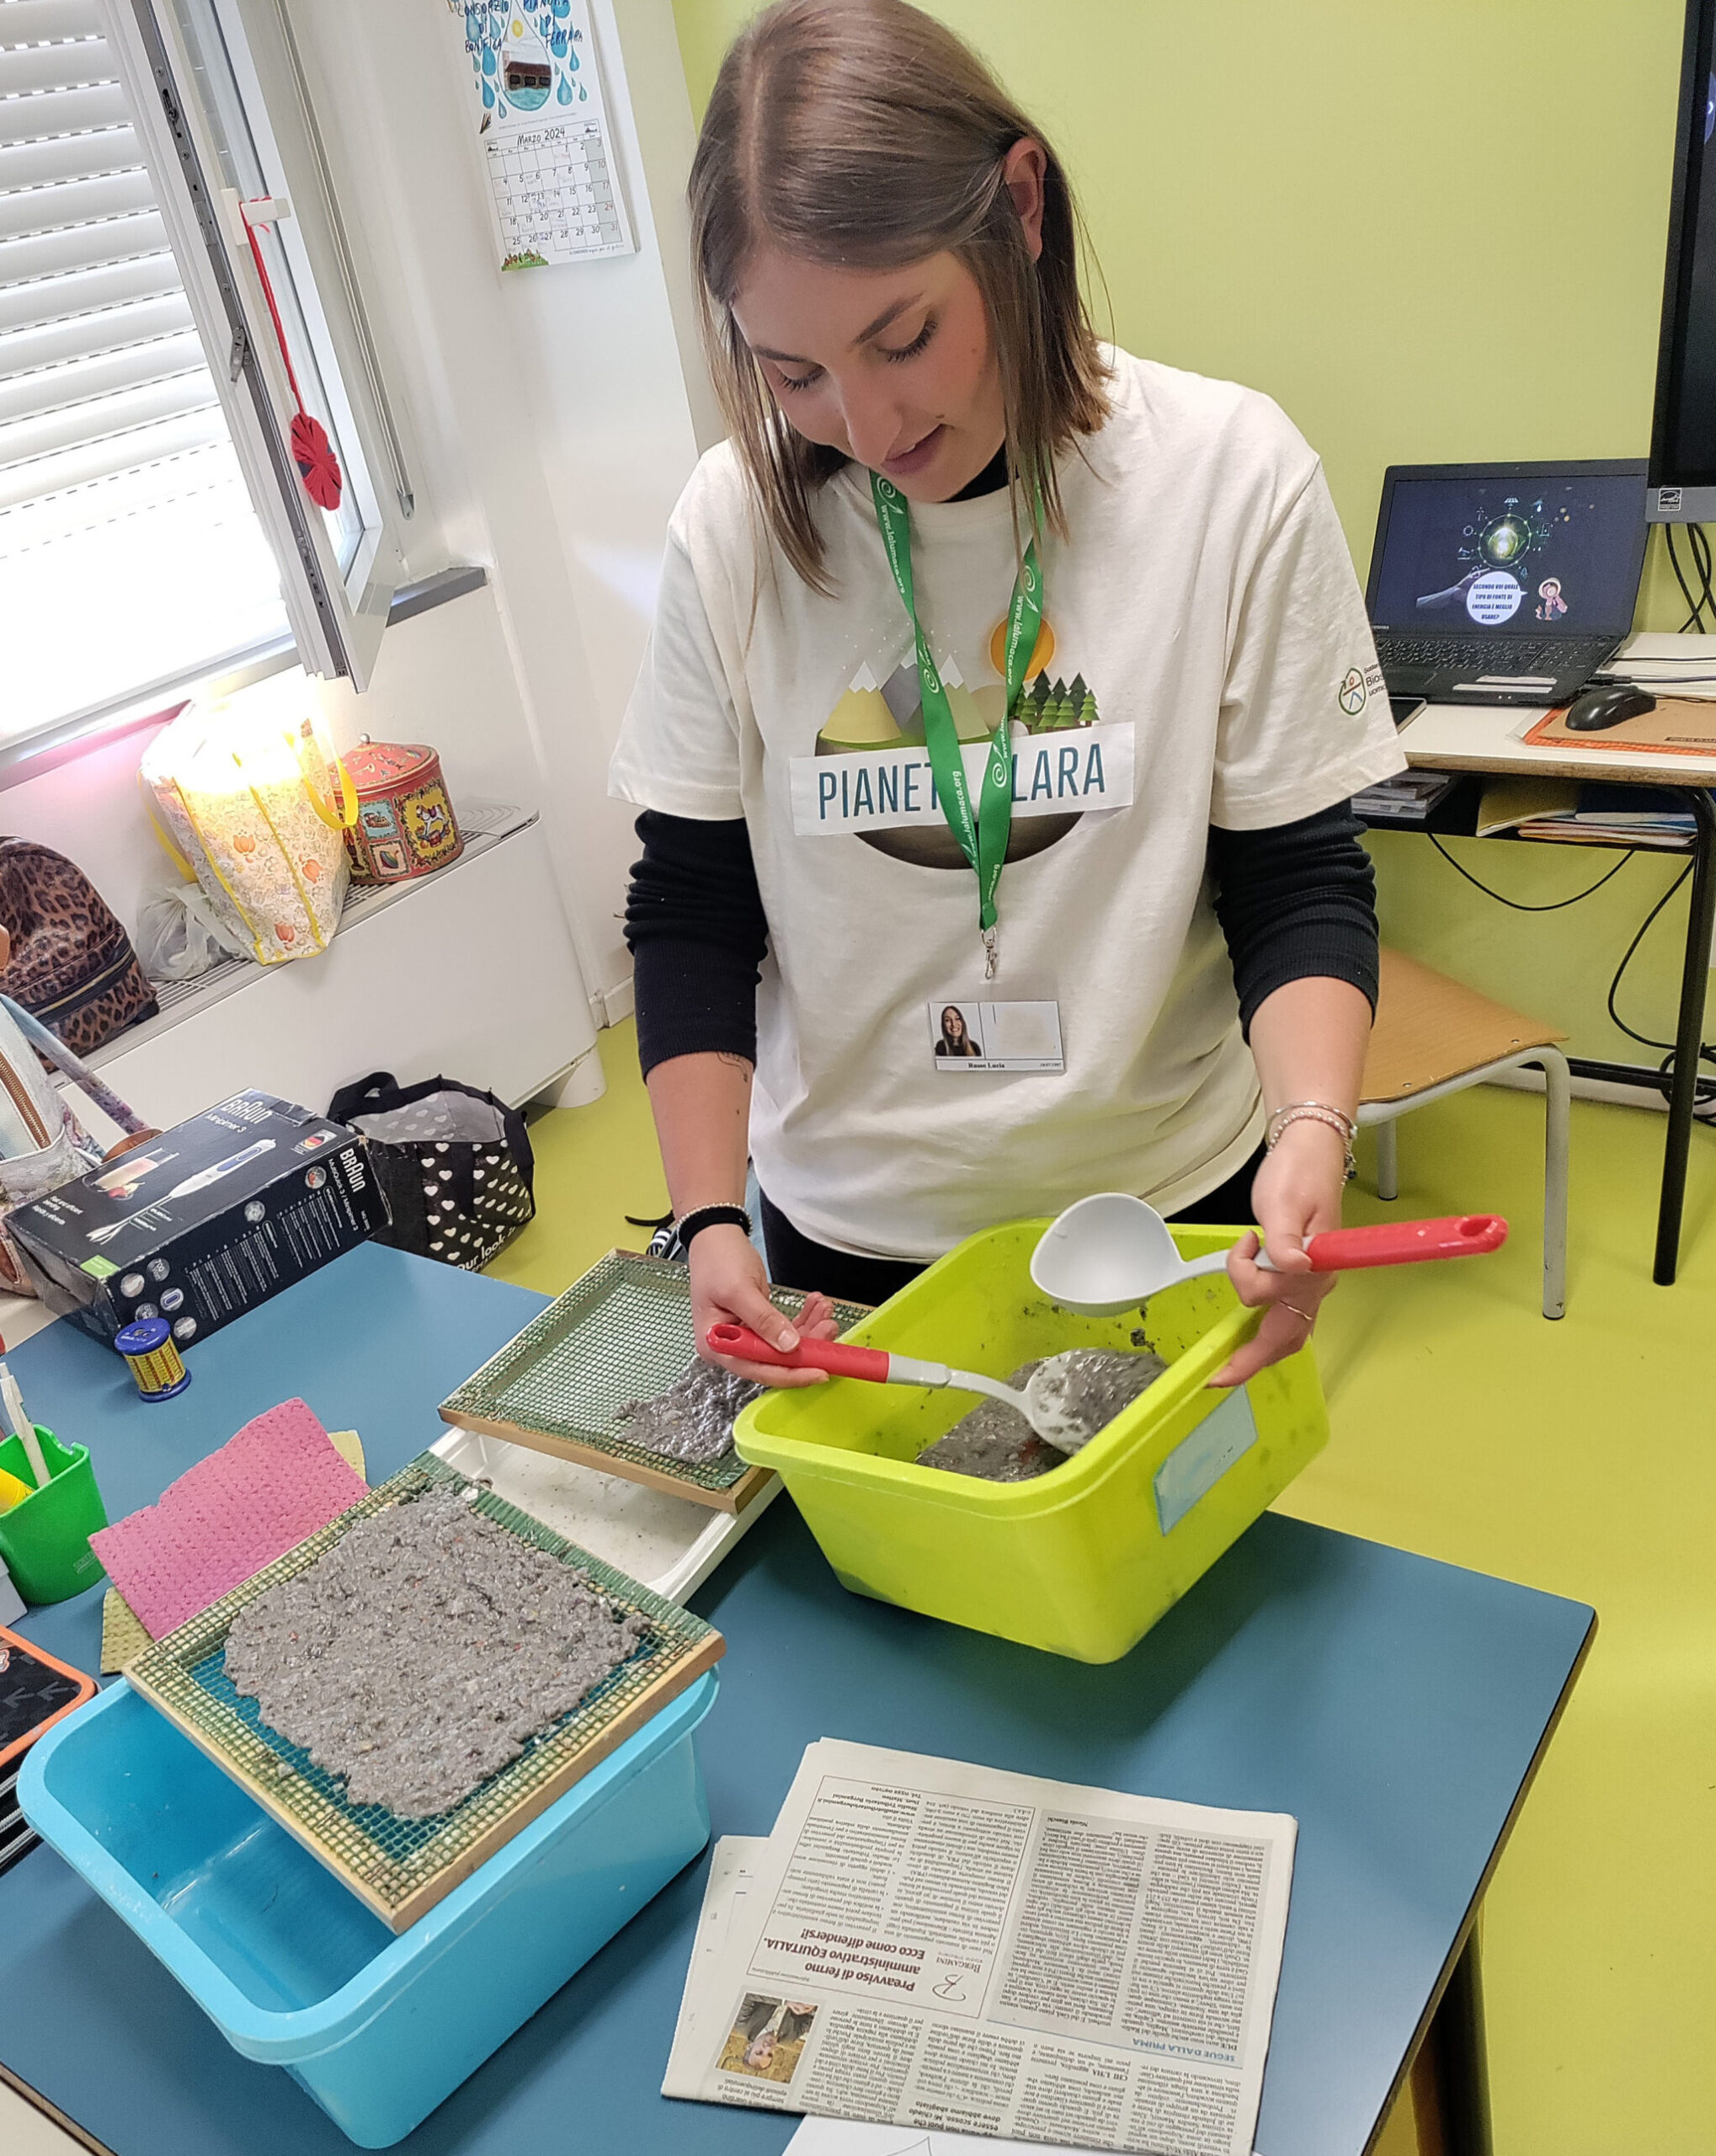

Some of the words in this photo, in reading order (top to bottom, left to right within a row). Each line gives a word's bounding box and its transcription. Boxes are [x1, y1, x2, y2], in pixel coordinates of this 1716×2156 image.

[546, 29, 583, 48] FERRARA
[544, 127, 565, 141] 2024
[540, 212, 548, 221] 20
[557, 210, 564, 218] 21
[572, 207, 579, 216] 22
[605, 202, 613, 211] 24
[545, 232, 552, 241] 27
[560, 230, 568, 238] 28
[575, 227, 584, 236] 29
[591, 225, 600, 233] 30
[881, 504, 905, 594] www.lalumaca.org
[1005, 595, 1024, 685] www.lalumaca.org
[818, 762, 939, 820] PIANET
[1011, 743, 1106, 803] LARA
[221, 1098, 274, 1124] BRAUN
[205, 1113, 238, 1131] Minipimer
[339, 1147, 366, 1193] BRAUN
[832, 1792, 864, 1802] Bergamini
[864, 1798, 896, 1807] Tributario
[813, 1843, 840, 1852] Bergamini
[842, 1848, 869, 1857] Tributario
[799, 1927, 865, 1950] difendersi!
[760, 1935, 829, 1958] EQUITALIA.
[864, 1939, 898, 1953] come
[897, 1945, 925, 1960] Ecco
[802, 1961, 840, 1978] fermo
[828, 1949, 920, 1976] amministrativo
[935, 1956, 981, 1973] BERGAMINI
[840, 1968, 855, 1981] di
[854, 1971, 915, 1992] Preavviso
[1132, 2037, 1165, 2050] PRIMA
[1167, 2044, 1202, 2057] DALLA
[1202, 2050, 1235, 2063] SEGUE
[907, 2108, 932, 2119] chiedo
[914, 2100, 948, 2113] sbagliato
[948, 2107, 981, 2119] abbiamo
[945, 2115, 971, 2125] scosso.
[982, 2113, 1000, 2123] dove
[972, 2121, 998, 2130] essere
